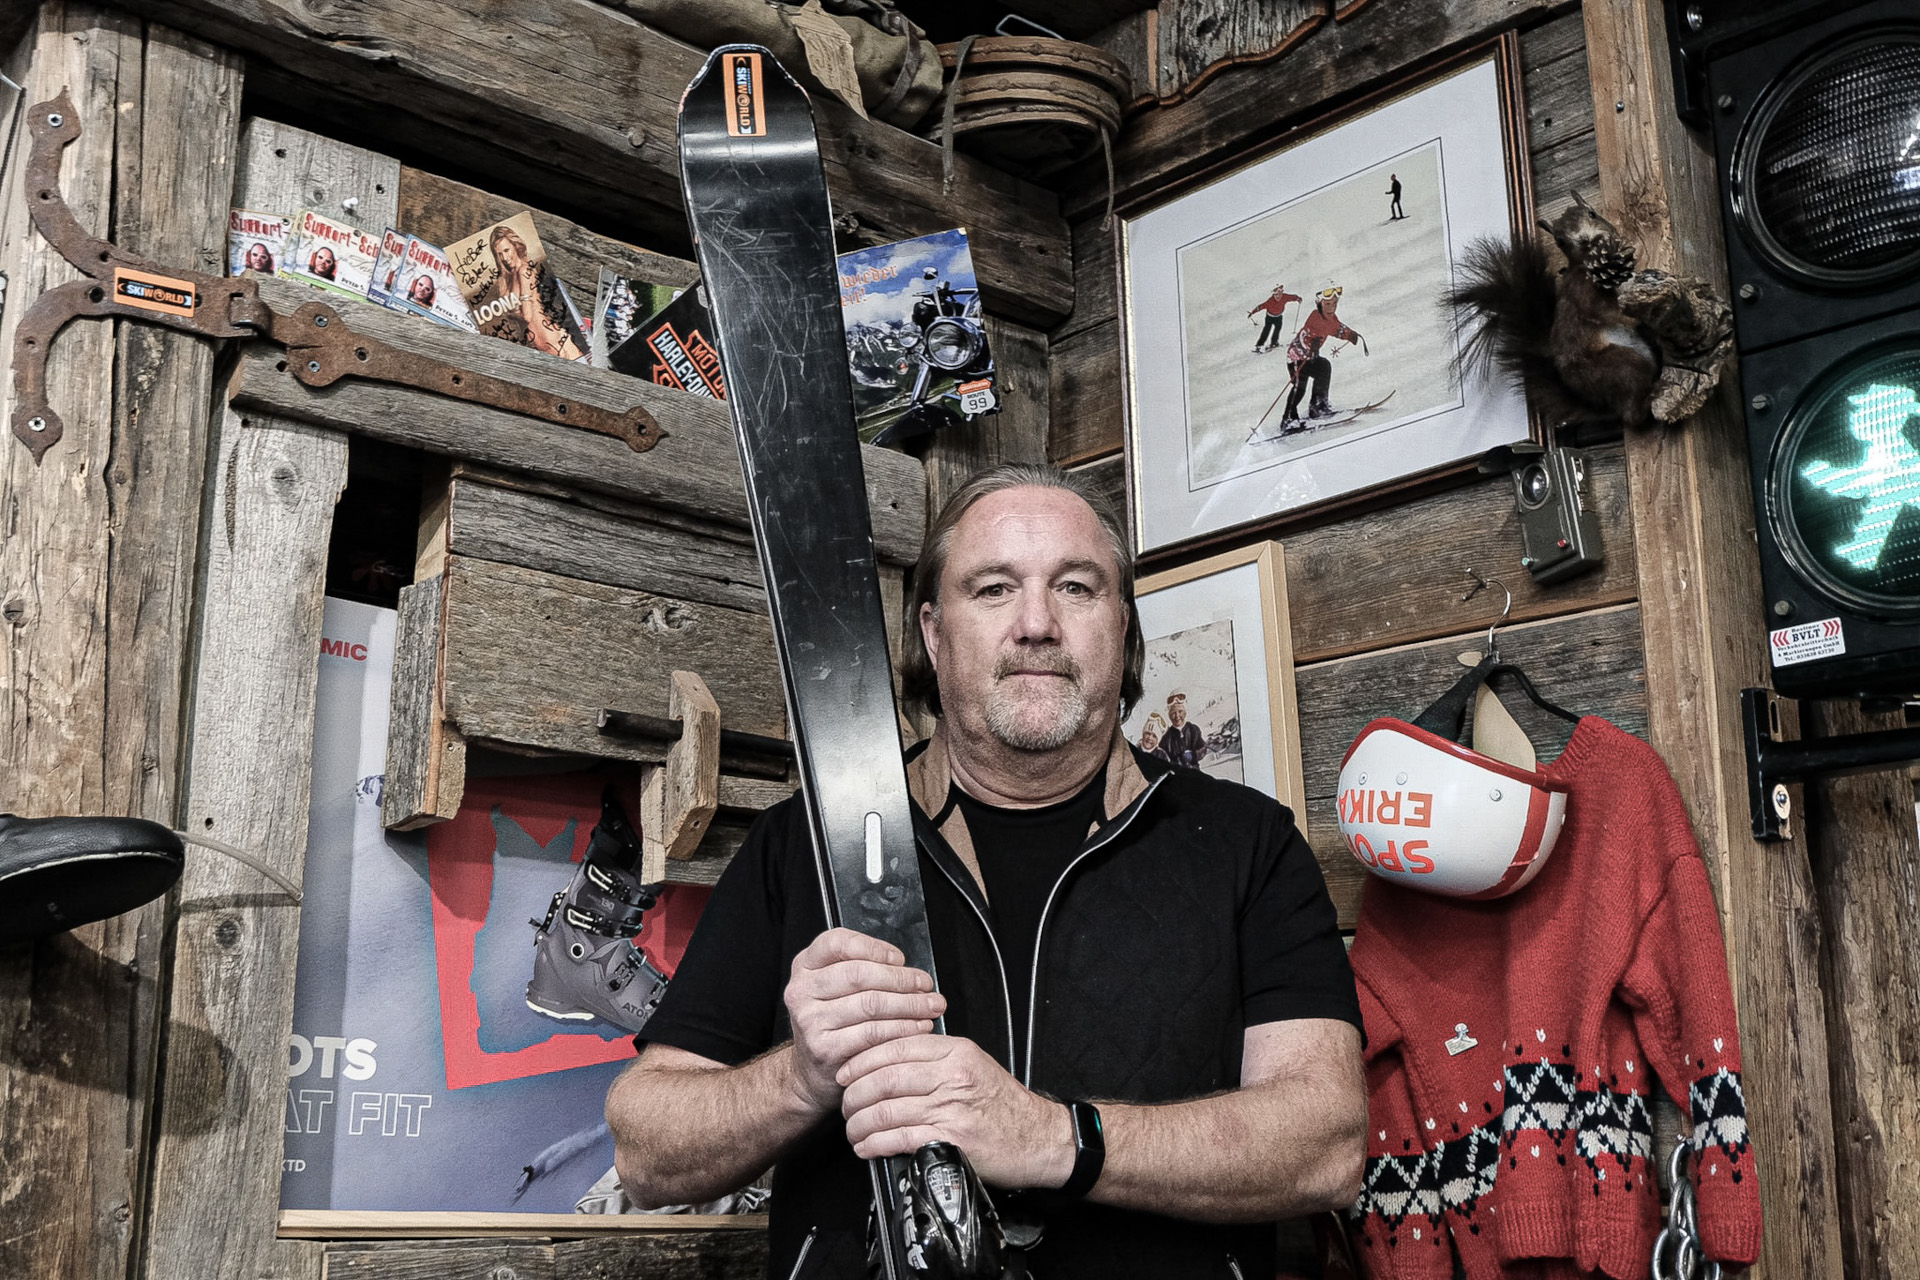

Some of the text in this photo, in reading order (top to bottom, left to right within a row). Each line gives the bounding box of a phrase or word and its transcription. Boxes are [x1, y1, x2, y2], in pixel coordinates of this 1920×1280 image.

[840, 265, 897, 288] wieder
[126, 284, 185, 304] SKIWORLD
[473, 291, 523, 326] LOONA
[966, 390, 986, 399] ROUTE
[969, 397, 987, 411] 99
[1792, 628, 1821, 643] BVLT
[1823, 641, 1840, 649] GmbH
[321, 637, 368, 661] MIC
[1338, 788, 1433, 828] ERIKA
[348, 1091, 432, 1137] FIT
